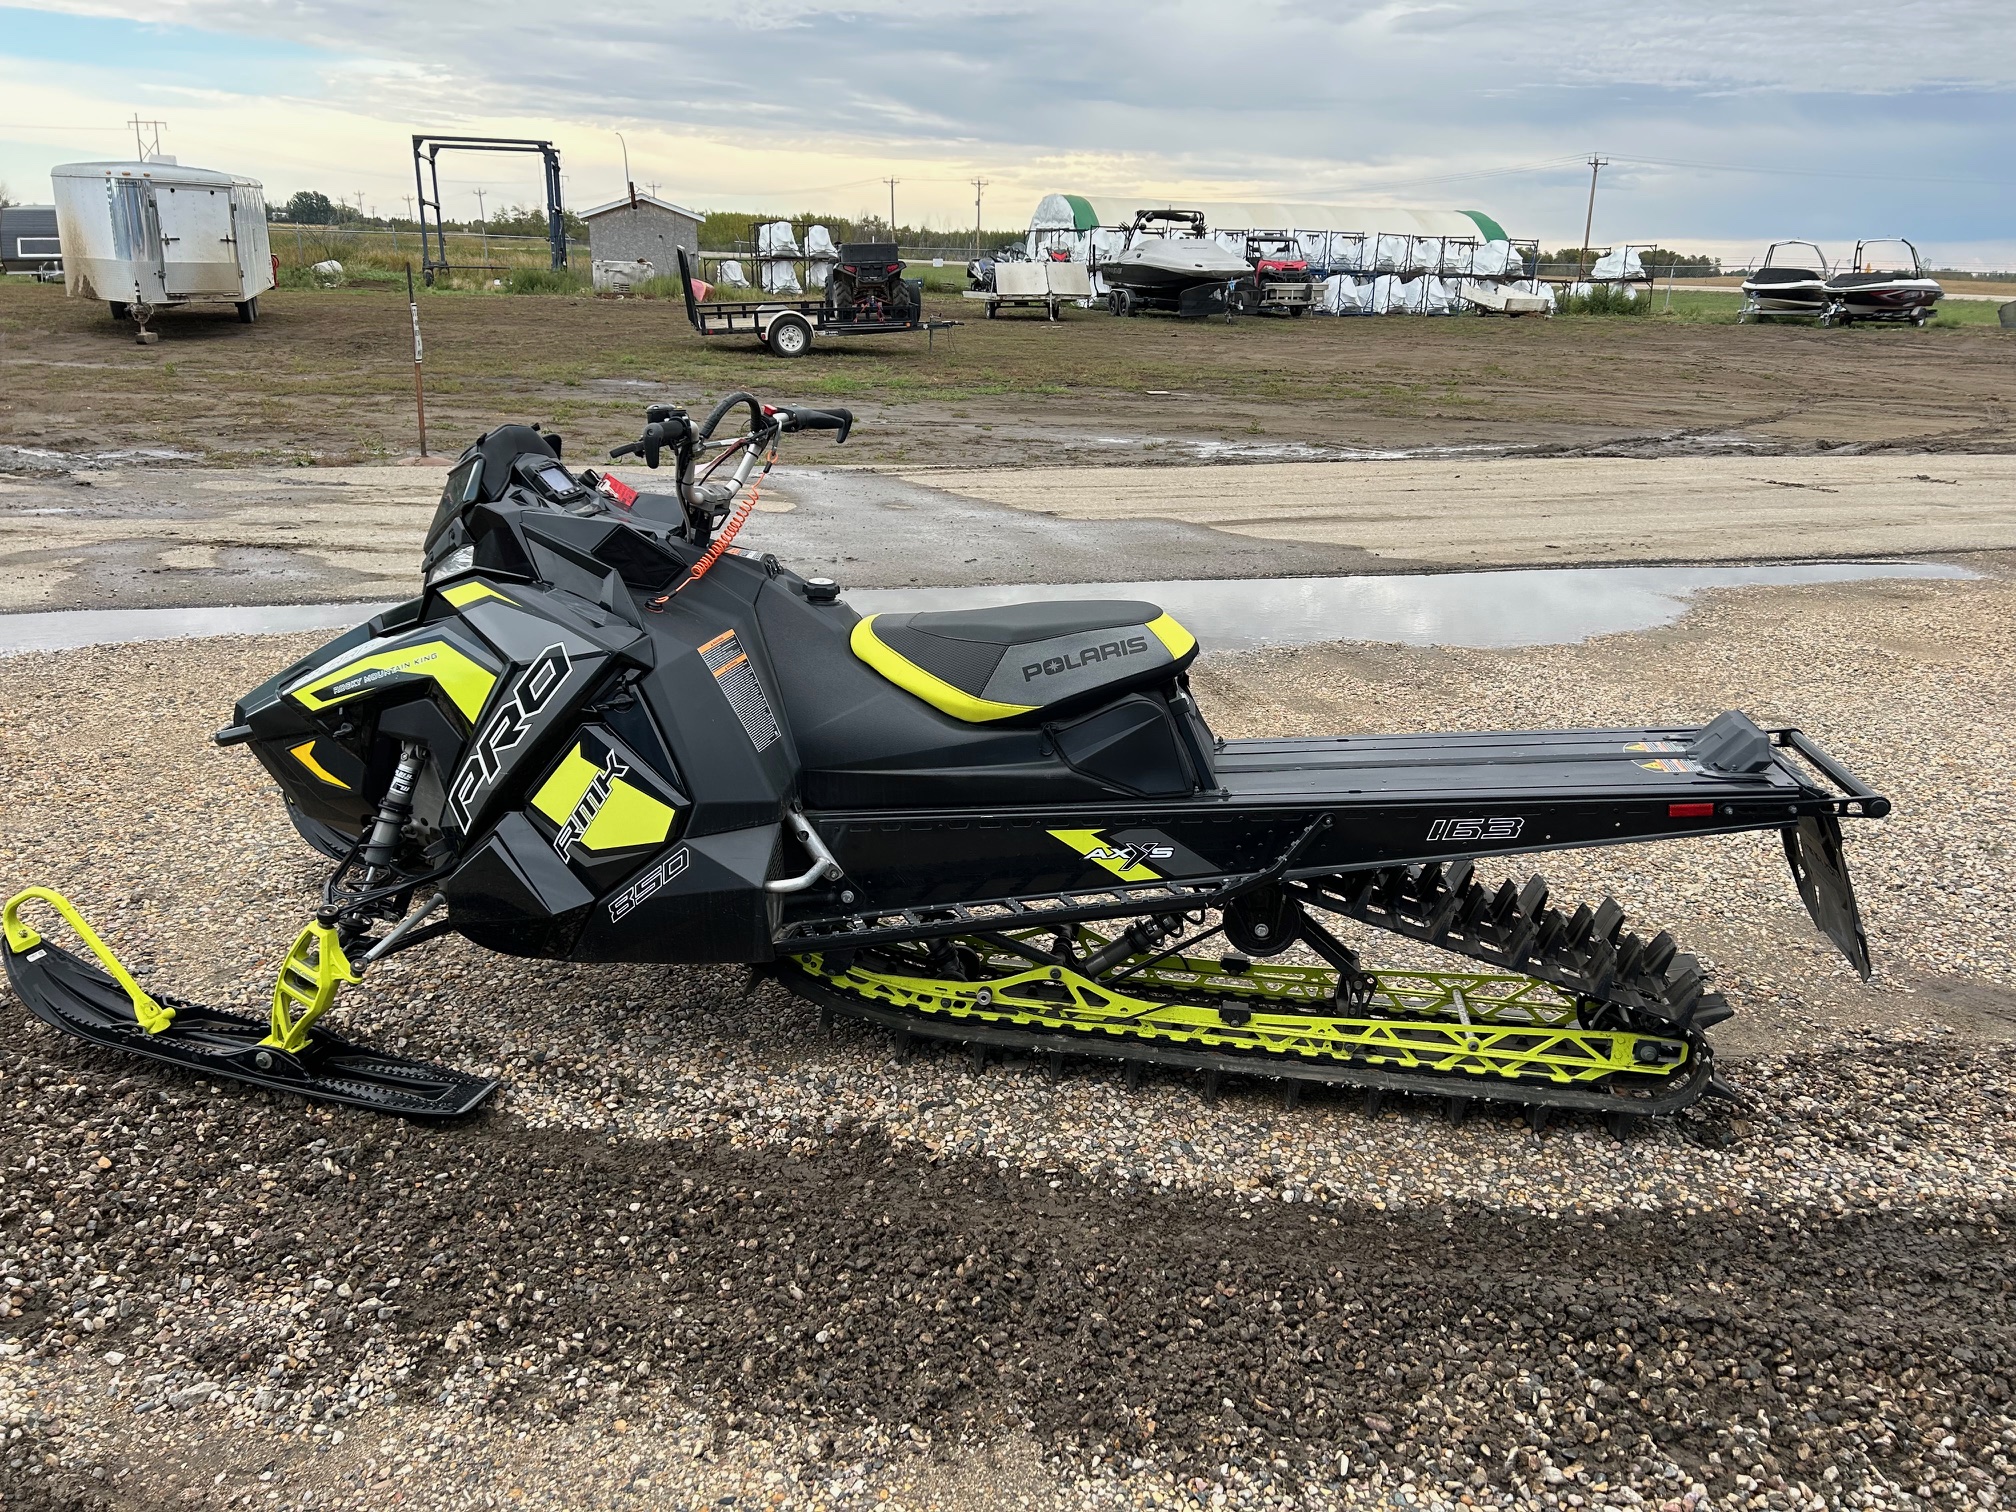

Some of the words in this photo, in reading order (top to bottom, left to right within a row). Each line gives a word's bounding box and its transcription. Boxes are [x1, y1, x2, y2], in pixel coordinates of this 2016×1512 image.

[333, 677, 362, 695] ROCKY
[363, 662, 411, 684] MOUNTAIN
[413, 652, 438, 666] KING
[1022, 636, 1148, 682] POLARIS
[448, 641, 574, 836] PRO
[553, 748, 629, 864] RMK
[1426, 817, 1525, 841] 163
[1083, 842, 1175, 871] AXYS
[608, 847, 689, 923] 850
